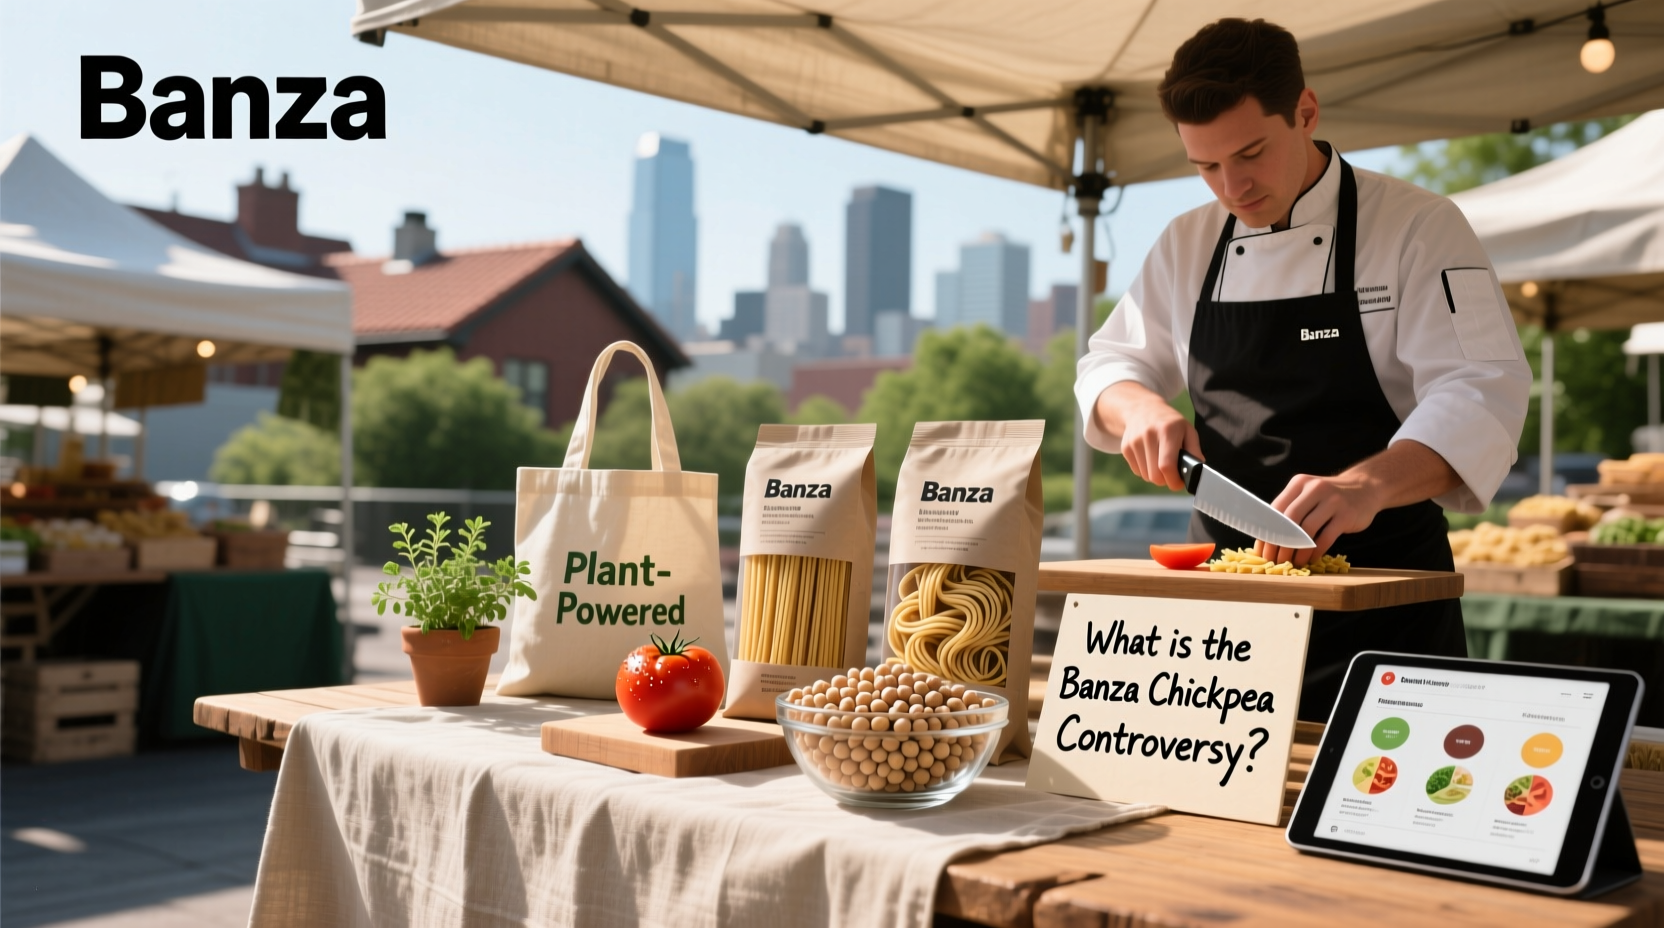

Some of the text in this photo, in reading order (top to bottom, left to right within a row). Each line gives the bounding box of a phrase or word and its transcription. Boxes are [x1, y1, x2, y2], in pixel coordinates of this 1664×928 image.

[1300, 328, 1340, 341] Banza
[764, 478, 832, 499] Banza
[920, 480, 994, 503] Banza
[563, 551, 671, 587] Plant-
[556, 591, 686, 627] Powered
[1085, 619, 1253, 663] What is the
[1059, 665, 1275, 726] Banza Chickpea
[1056, 713, 1270, 788] Controversy?
